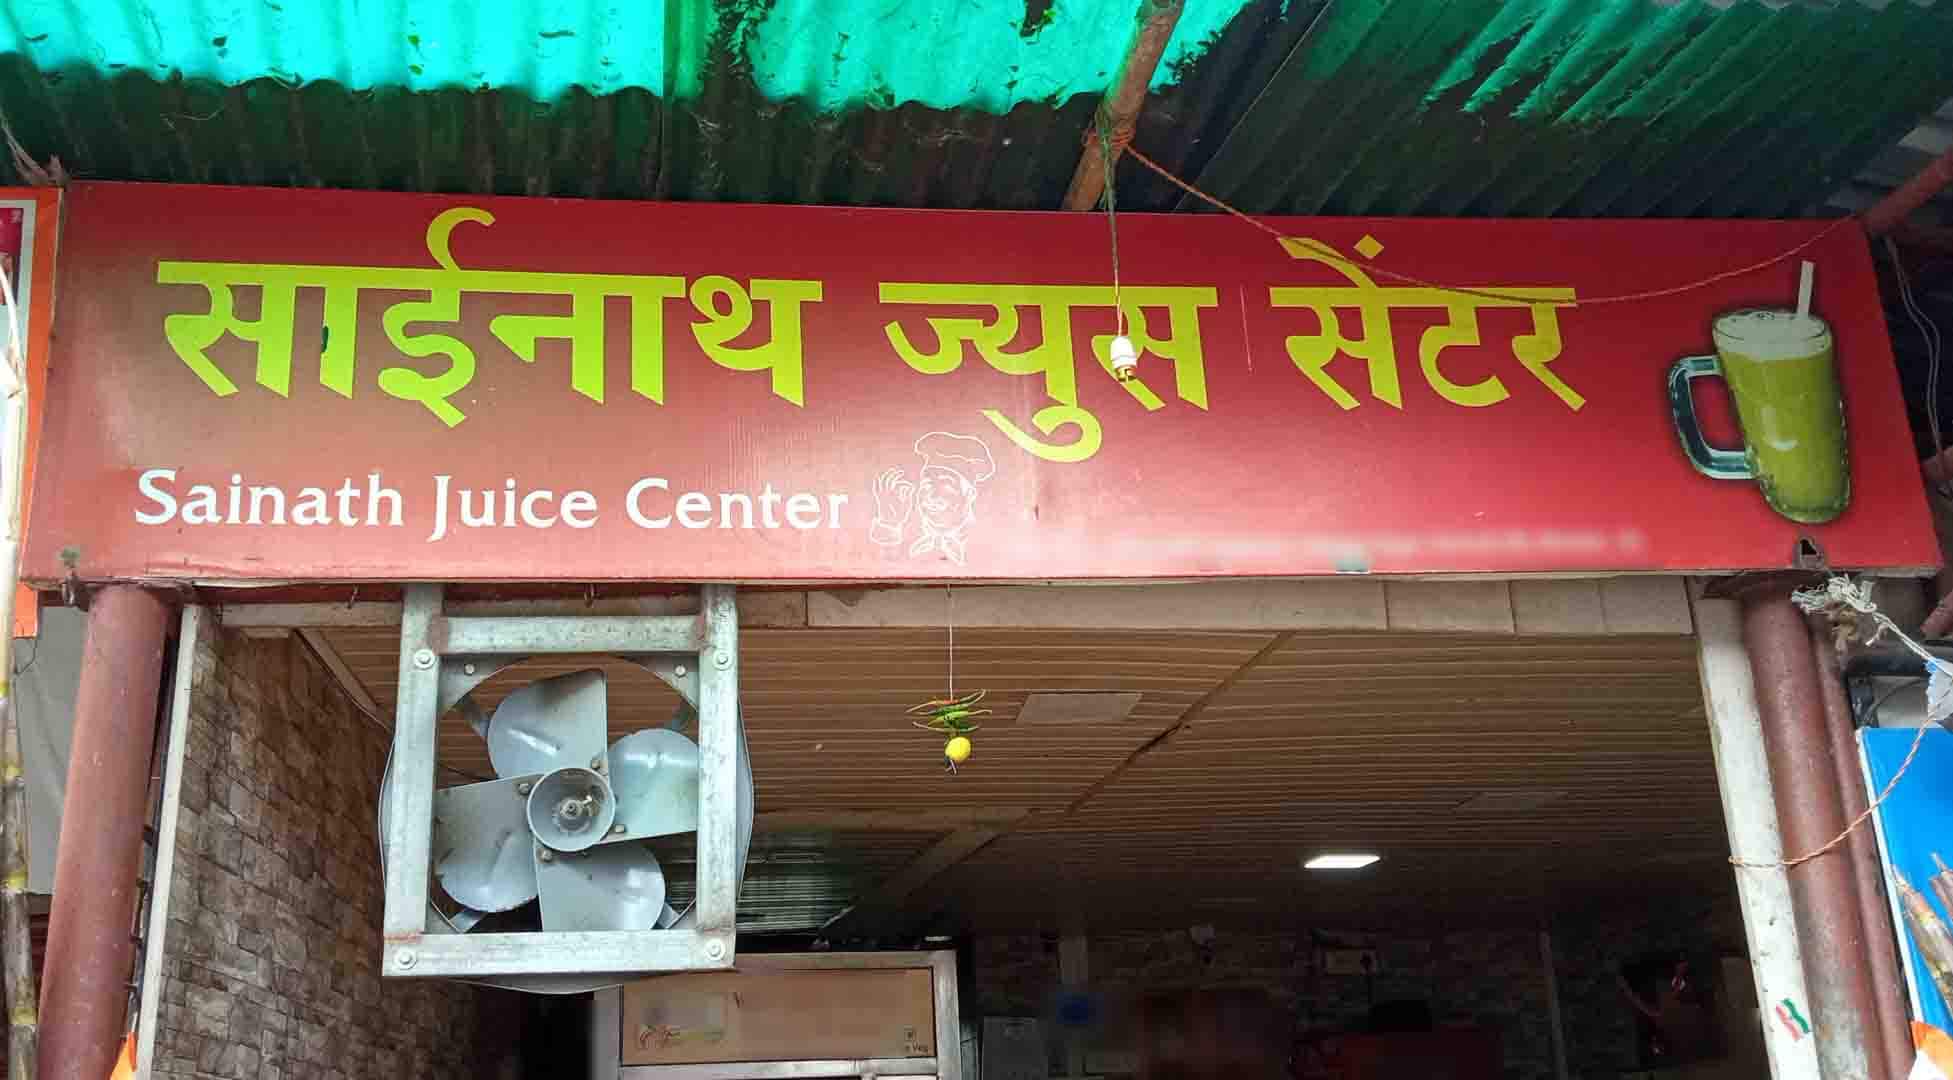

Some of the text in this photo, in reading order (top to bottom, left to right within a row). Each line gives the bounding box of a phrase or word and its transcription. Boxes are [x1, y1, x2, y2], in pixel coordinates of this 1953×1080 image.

[158, 208, 1585, 462] साईनाथ ज्युस सेंटर
[134, 469, 849, 543] Sainath Juice Center
